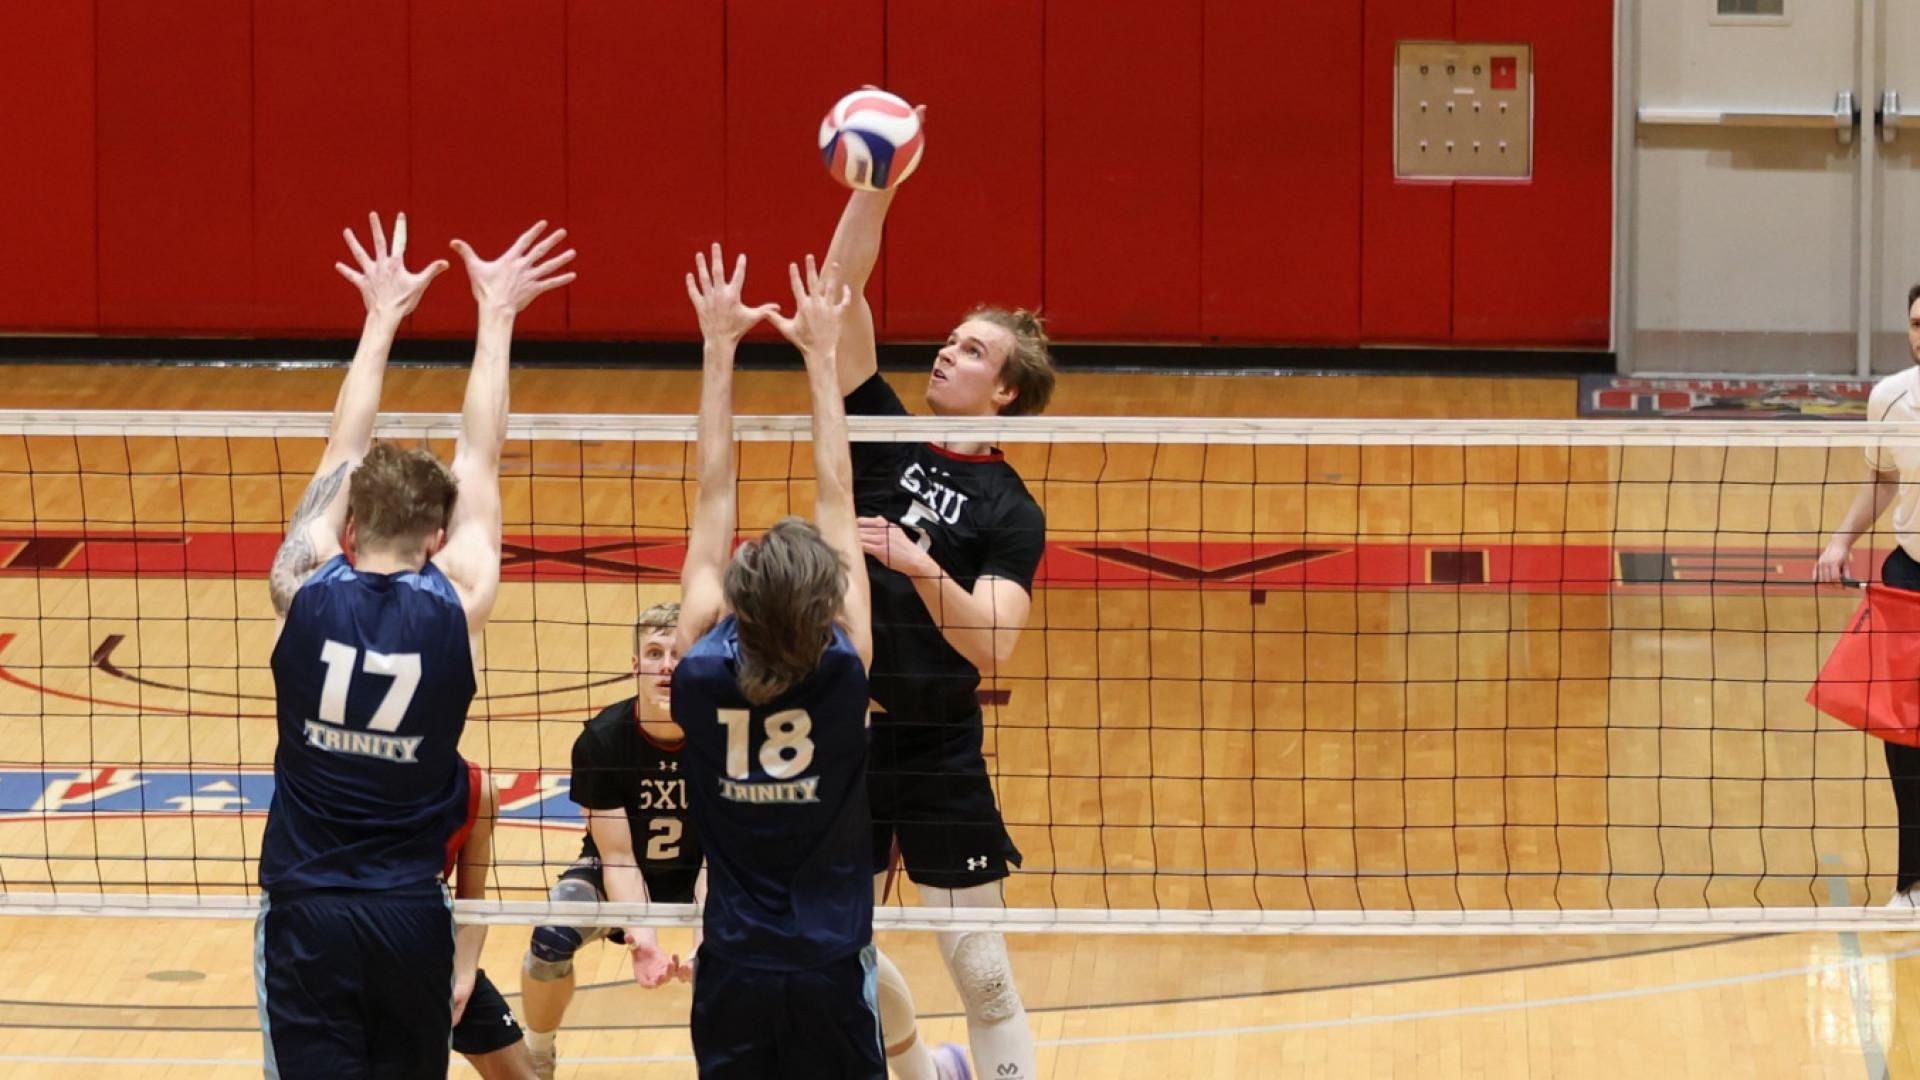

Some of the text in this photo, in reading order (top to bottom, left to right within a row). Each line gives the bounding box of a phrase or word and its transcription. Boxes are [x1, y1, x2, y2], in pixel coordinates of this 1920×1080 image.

[900, 463, 968, 524] SXU
[318, 639, 422, 733] 17
[303, 717, 424, 763] TRINITY
[716, 708, 815, 780] 18
[719, 775, 821, 804] TRINITY
[646, 817, 683, 861] 2
